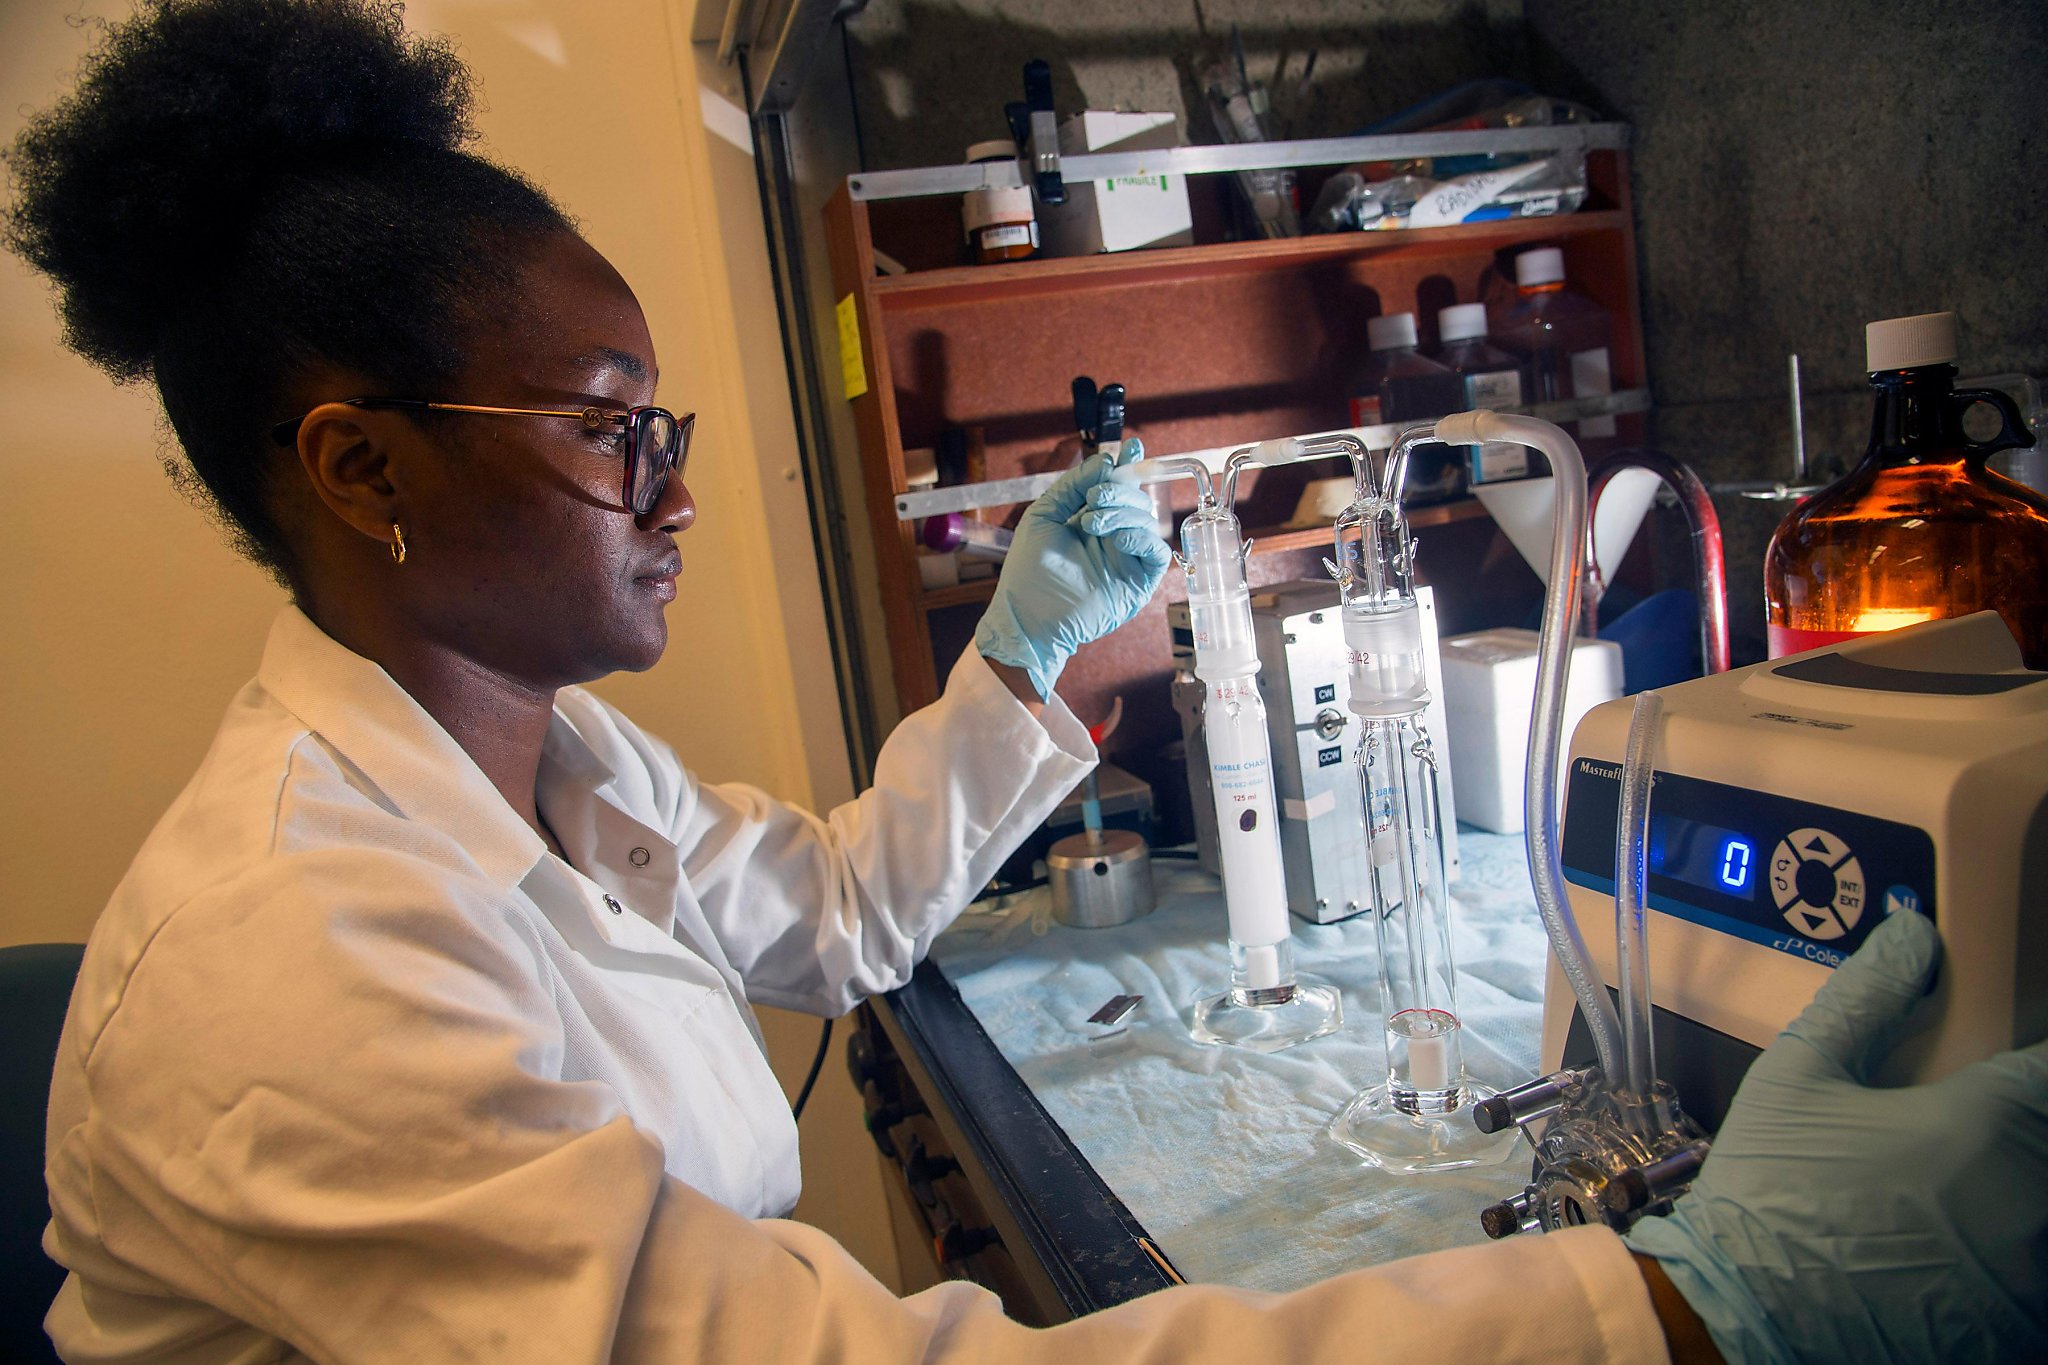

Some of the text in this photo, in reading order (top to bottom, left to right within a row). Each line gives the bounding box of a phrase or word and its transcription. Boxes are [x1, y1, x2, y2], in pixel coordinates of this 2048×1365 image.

[1319, 687, 1334, 700] CW
[1320, 748, 1340, 763] CCW
[1233, 794, 1246, 802] 125
[1722, 841, 1750, 887] 0
[1840, 896, 1860, 908] EXT
